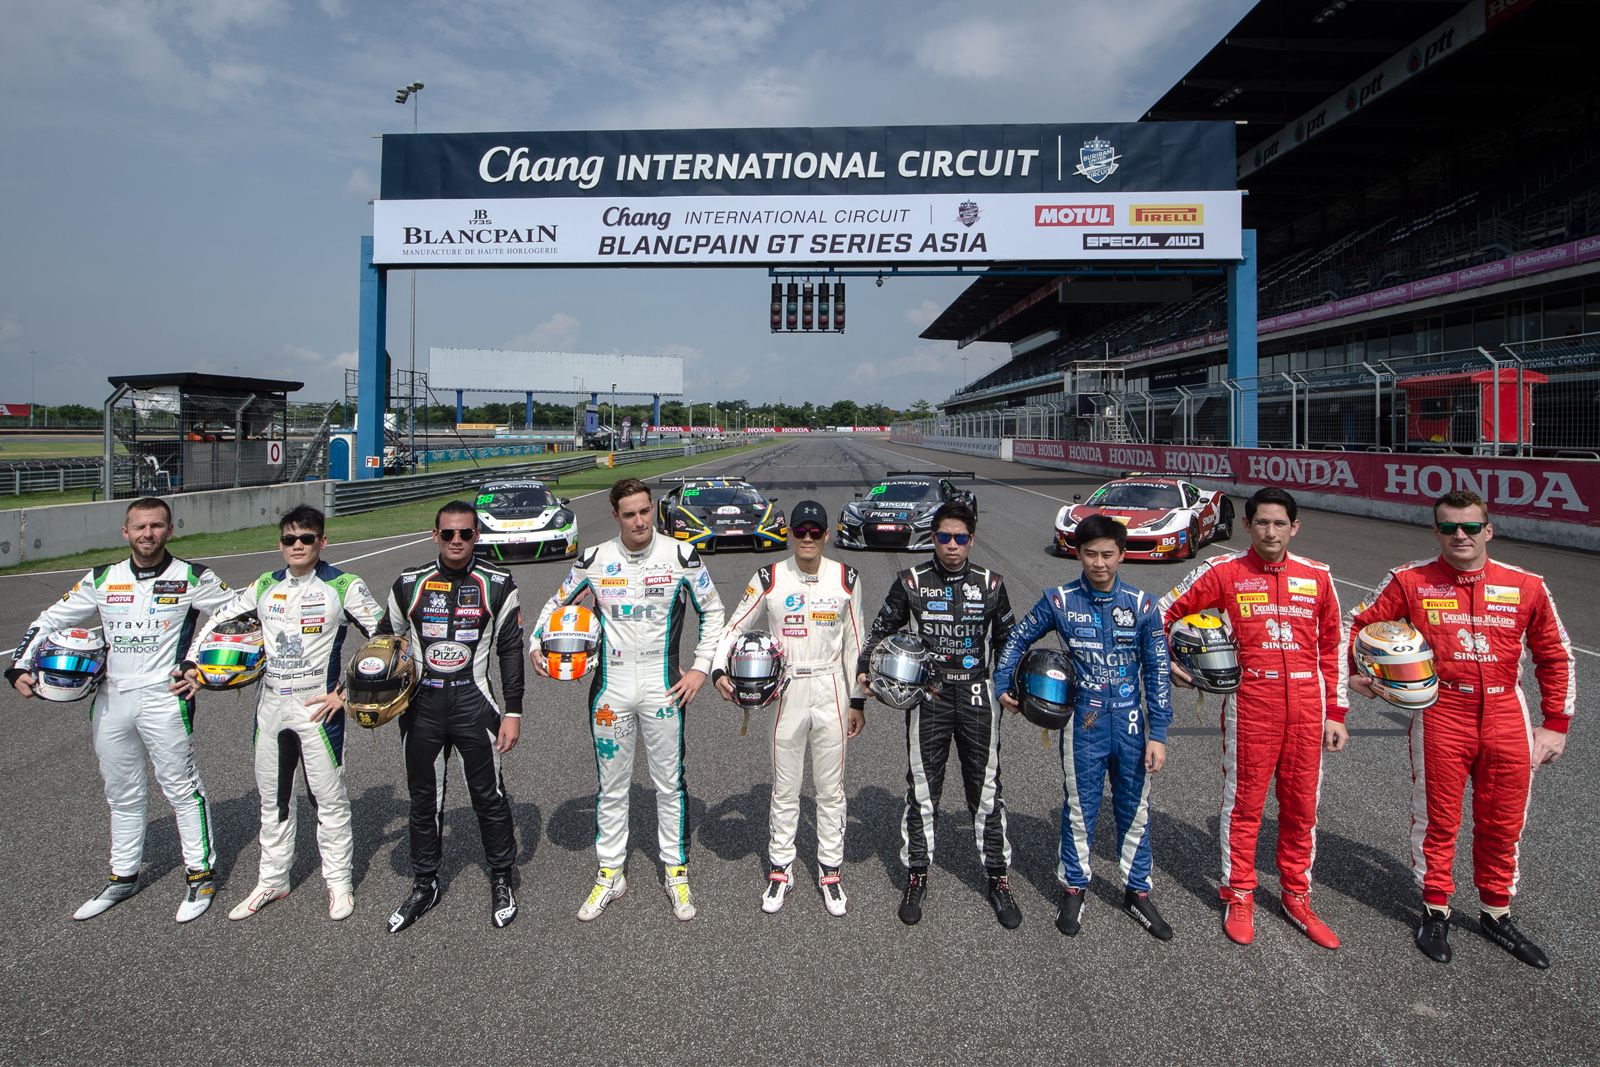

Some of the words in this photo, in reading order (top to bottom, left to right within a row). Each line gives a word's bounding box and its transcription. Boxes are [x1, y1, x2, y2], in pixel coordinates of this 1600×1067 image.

[1424, 25, 1455, 67] ptt
[1360, 71, 1384, 105] ptt
[1306, 109, 1326, 139] ptt
[1263, 139, 1279, 164] ptt
[478, 146, 604, 190] Chang
[616, 150, 886, 181] INTERNATIONAL
[898, 149, 1039, 178] CIRCUIT
[602, 206, 671, 230] Chang
[684, 209, 827, 226] INTERNATIONAL
[834, 208, 910, 224] CIRCUIT
[1038, 207, 1112, 225] MOTUL
[1135, 208, 1197, 223] PIRELLI
[402, 225, 559, 245] BLANCPAIN
[598, 234, 749, 256] BLANCPAIN
[767, 233, 804, 255] GT
[809, 233, 913, 254] SERIES
[919, 232, 988, 254] ASIA
[1086, 236, 1160, 248] SPECIAL
[402, 248, 462, 257] MANUFACTURE
[465, 248, 475, 256] DE
[478, 248, 504, 256] HAUTE
[506, 247, 559, 256] HORLOGERIE
[1014, 442, 1035, 456] HONDA
[1038, 443, 1064, 459] HONDA
[1068, 445, 1103, 462] HONDA
[1109, 448, 1156, 468] HONDA
[1165, 451, 1233, 474] HONDA
[1249, 456, 1359, 489] HONDA
[683, 489, 700, 497] 66
[871, 485, 888, 495] 59
[1384, 463, 1589, 513] HONDA
[476, 494, 495, 505] 88
[1162, 537, 1176, 546] BG
[785, 595, 805, 608] est
[1291, 595, 1316, 604] MOTUL
[268, 604, 285, 614] TMB
[457, 608, 481, 616] MOTUL
[1252, 603, 1288, 612] Cavallino
[1289, 605, 1314, 615] Motors
[1487, 604, 1518, 613] MOTUL
[784, 615, 805, 623] CTI
[812, 612, 836, 620] PIRELLI
[1441, 612, 1482, 622] Cavallino
[1484, 614, 1515, 625] Motors
[110, 620, 171, 630] gravity
[923, 623, 984, 637] SINGHA
[114, 635, 159, 645] CRAFT
[1262, 641, 1300, 650] SINGHA
[113, 644, 159, 654] bamboo
[432, 650, 465, 660] PIZZA
[1073, 649, 1137, 667] SINGHA
[1454, 652, 1498, 663] SINGHA
[269, 658, 312, 670] SINGHA
[209, 674, 226, 683] TMB
[266, 668, 325, 680] ORSCHE
[1049, 671, 1064, 680] BELL
[655, 706, 674, 720] 45
